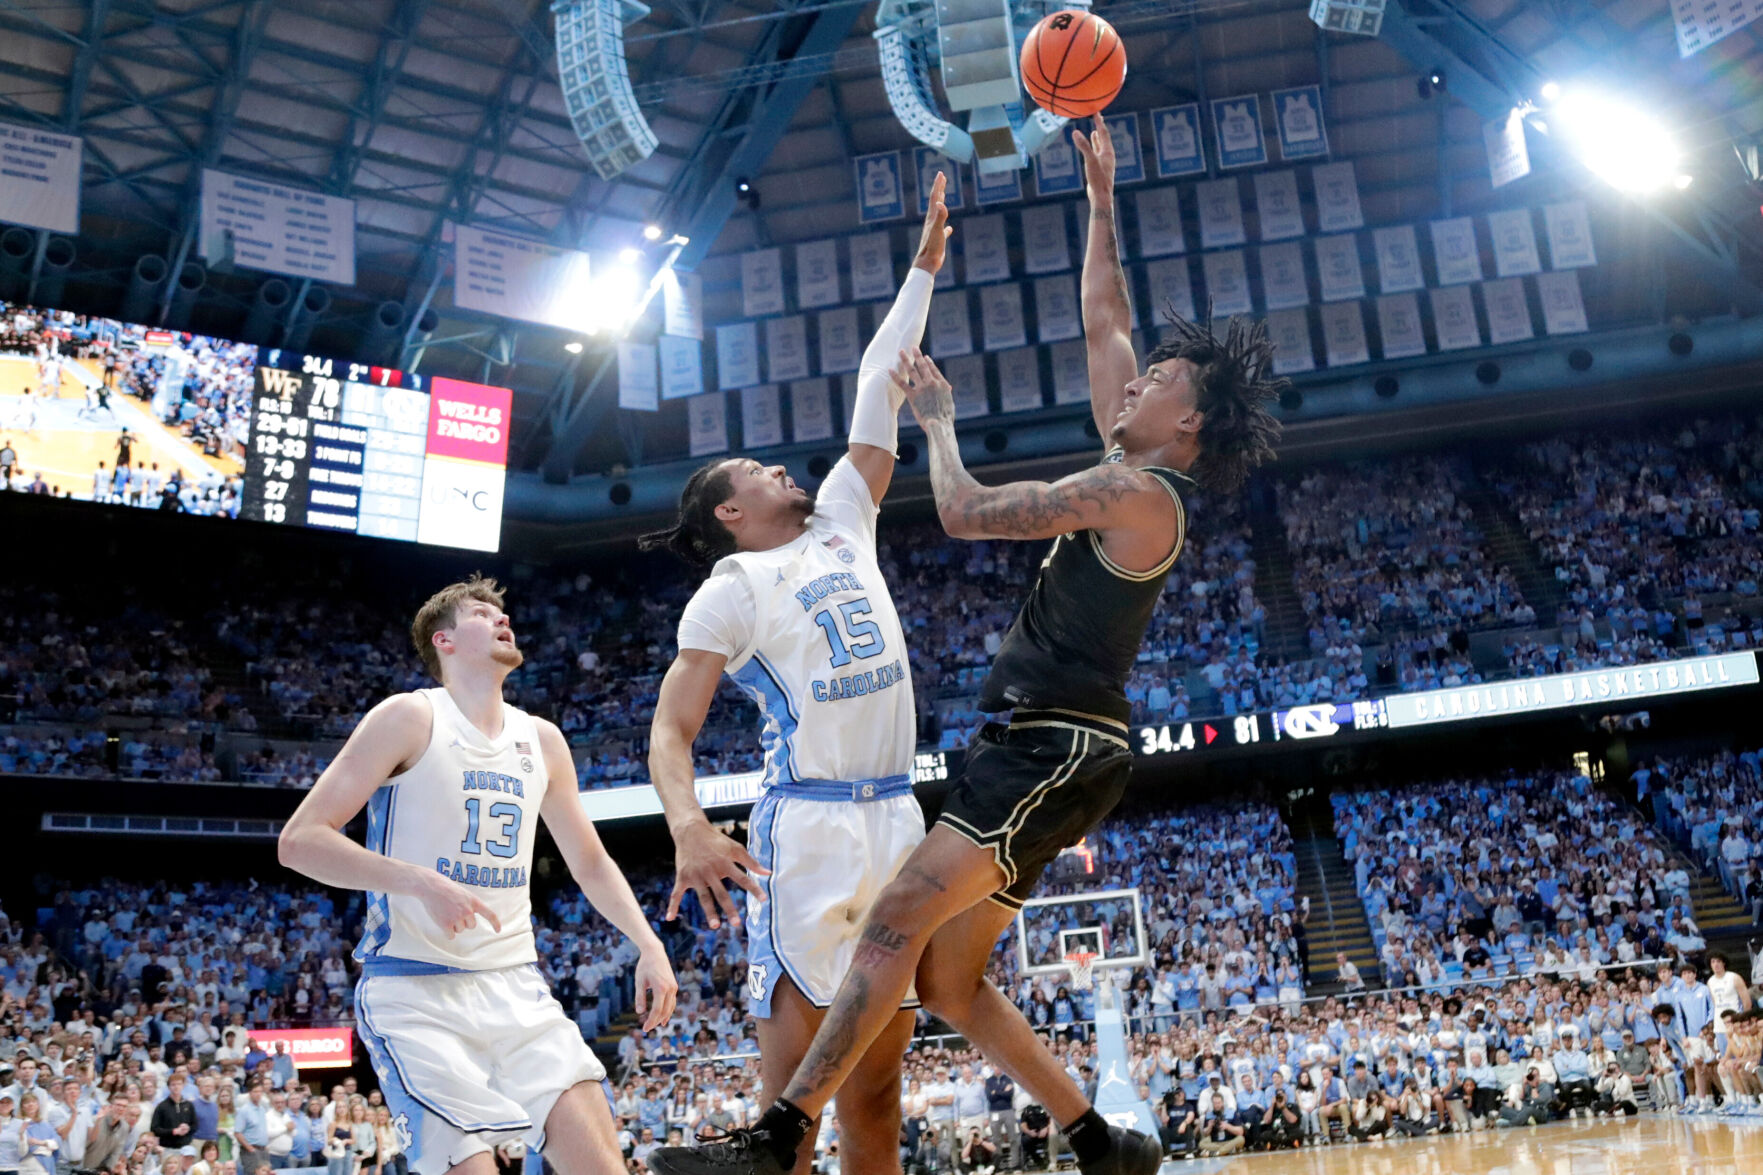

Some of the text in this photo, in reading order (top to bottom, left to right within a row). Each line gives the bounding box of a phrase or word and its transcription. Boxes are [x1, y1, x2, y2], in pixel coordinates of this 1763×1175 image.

[261, 367, 302, 401] WF
[311, 376, 340, 408] 78
[381, 369, 391, 386] 7
[438, 399, 502, 425] WELLS
[437, 419, 501, 444] FARGO
[264, 480, 289, 501] 27
[263, 503, 286, 523] 13
[795, 572, 865, 613] NORTH
[814, 597, 886, 669] 15
[812, 659, 905, 702] CAROLINA
[1415, 659, 1731, 720] CAROLINA BASKETBALL
[1139, 714, 1260, 755] 34.4 81
[939, 752, 946, 765] 1
[463, 770, 525, 799] NORTH
[916, 767, 935, 783] FLS:
[460, 797, 523, 859] 13
[437, 857, 528, 889] CAROLINA
[293, 1038, 345, 1054] FARGO
